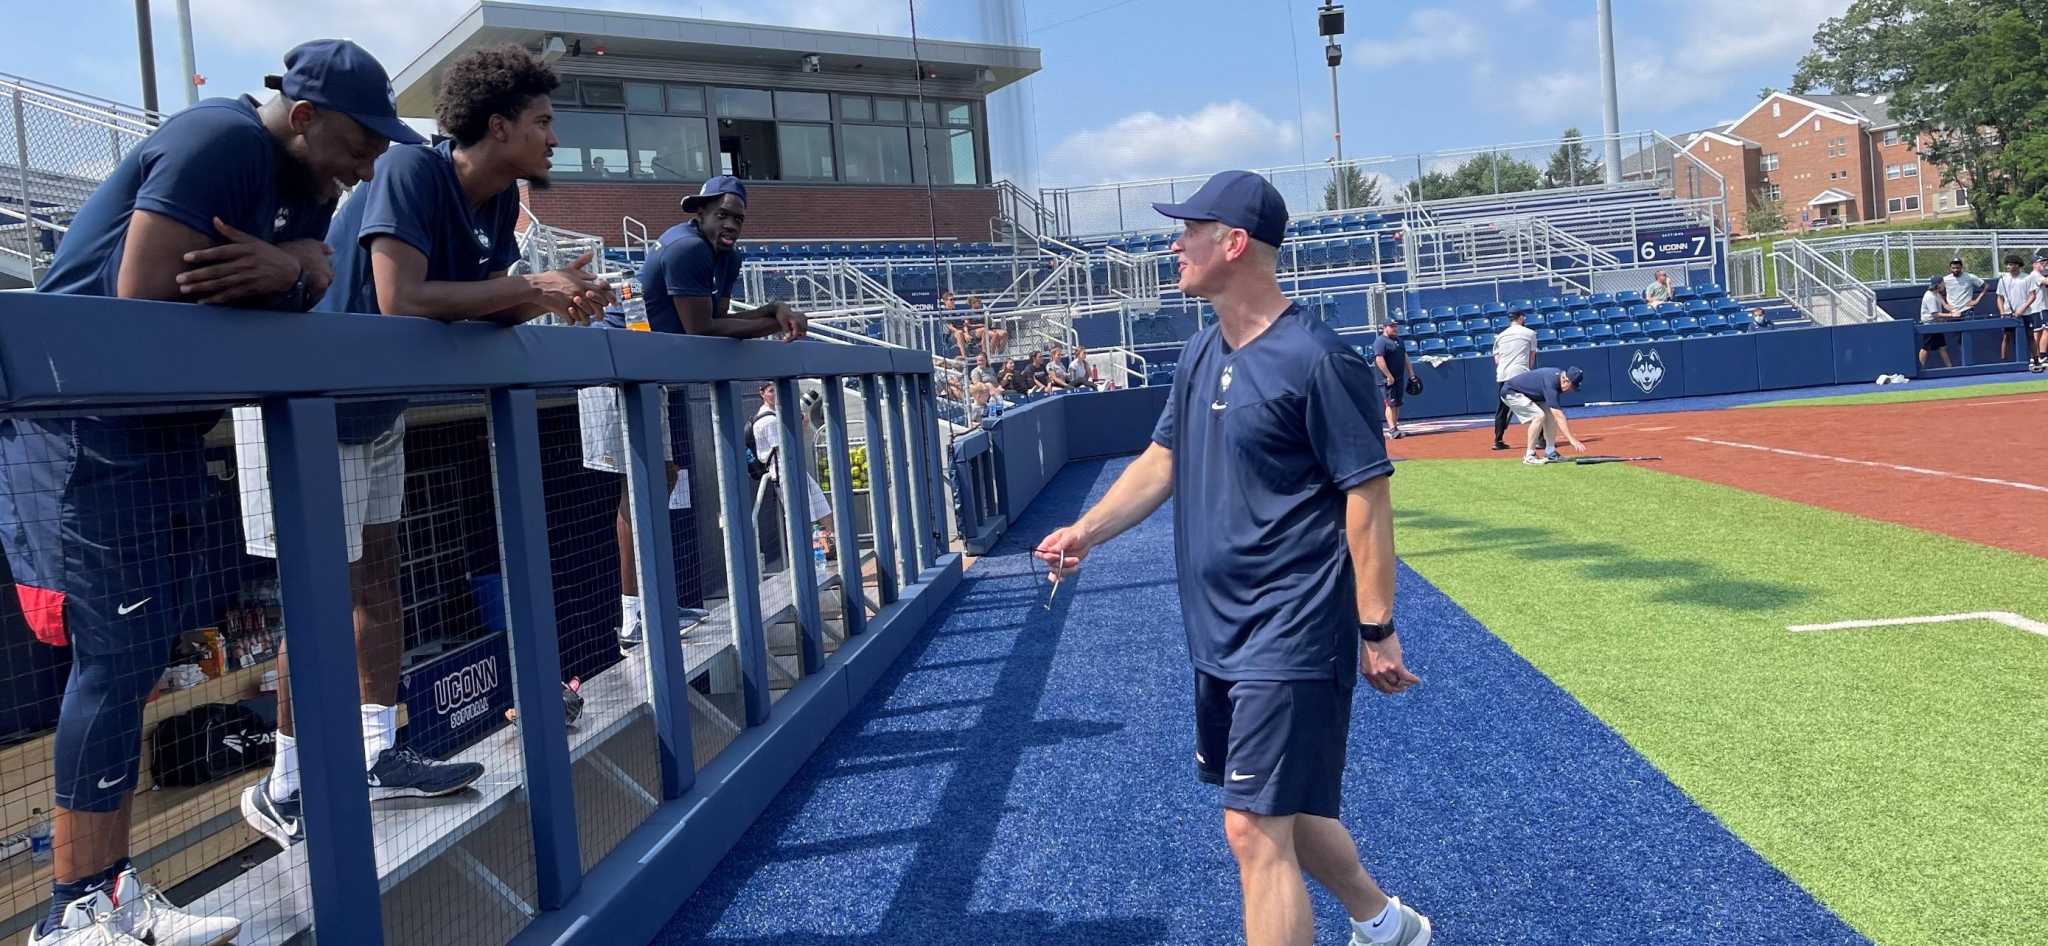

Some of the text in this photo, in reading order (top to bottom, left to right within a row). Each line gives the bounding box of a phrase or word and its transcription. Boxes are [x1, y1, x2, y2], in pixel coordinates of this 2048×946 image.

[1641, 236, 1706, 260] 6 UCONN 7
[434, 655, 498, 715] UCONN
